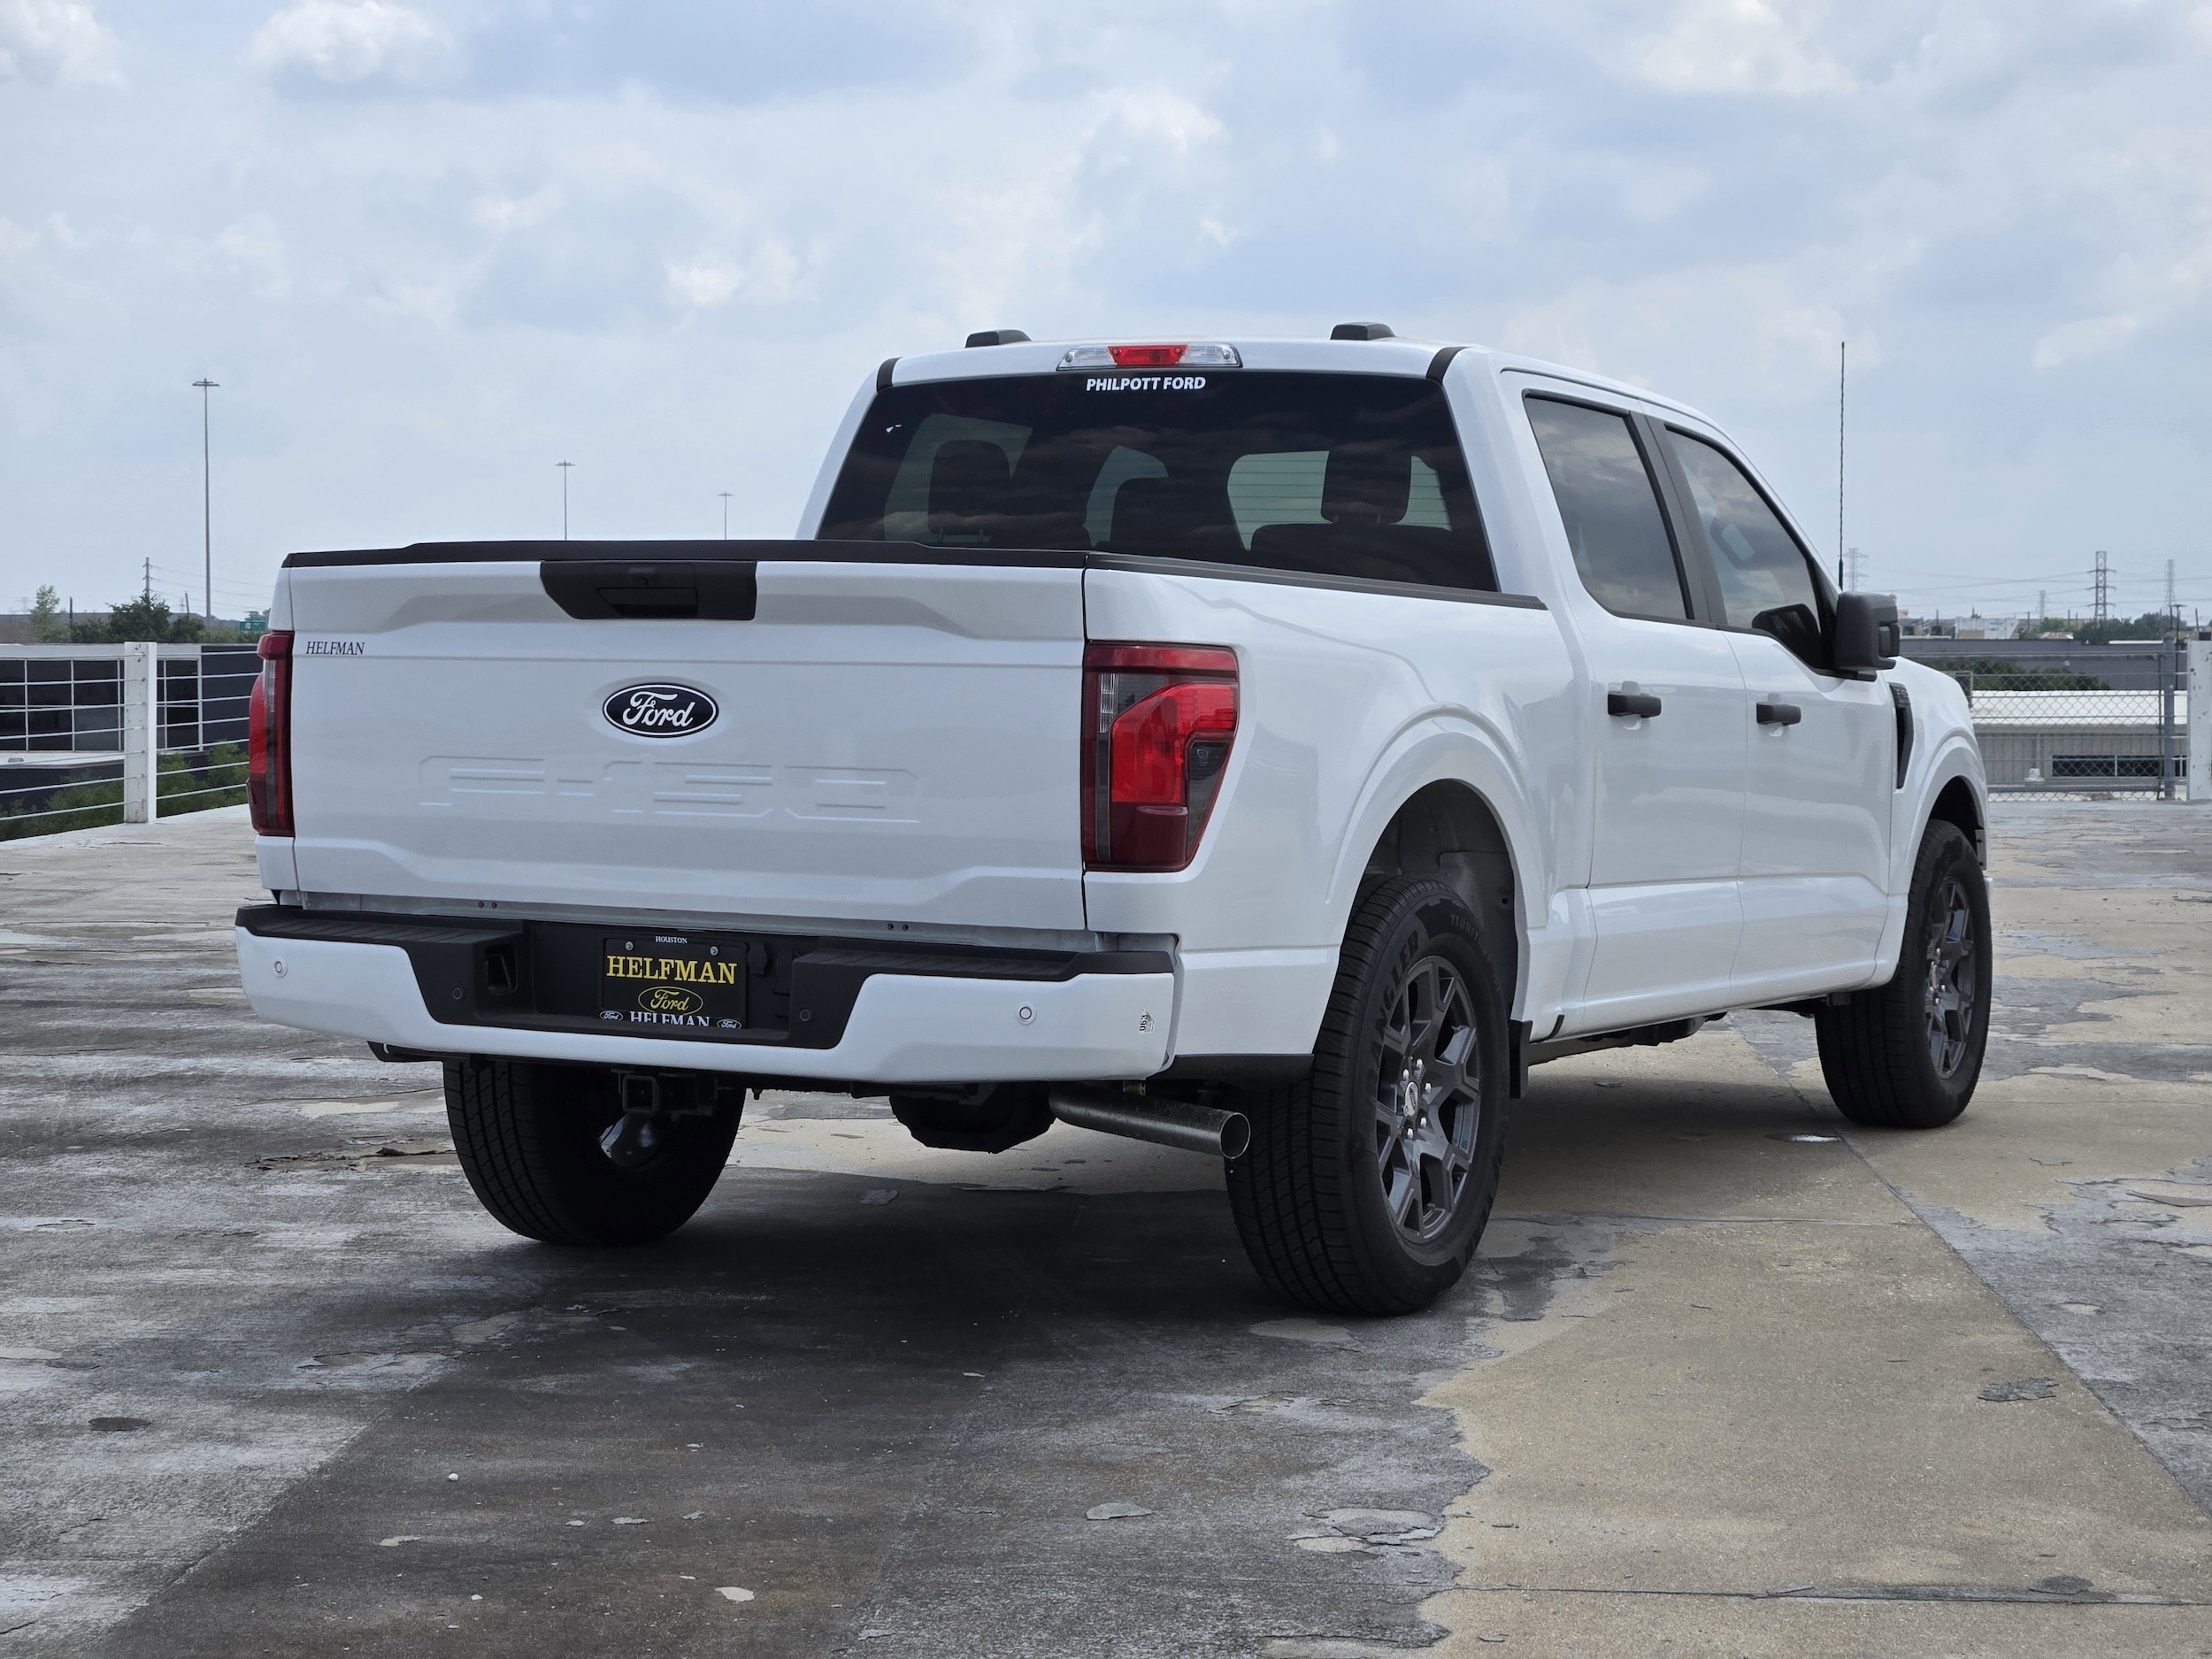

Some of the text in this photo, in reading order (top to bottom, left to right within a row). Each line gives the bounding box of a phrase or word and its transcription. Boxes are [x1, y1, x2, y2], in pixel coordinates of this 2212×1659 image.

[1086, 376, 1206, 391] PHILPOTT FORD
[305, 641, 365, 655] HELFMAN
[622, 691, 695, 727] Ford
[655, 935, 687, 944] HOUSTON
[606, 955, 737, 985] HELFMAN
[649, 988, 690, 1011] Ford
